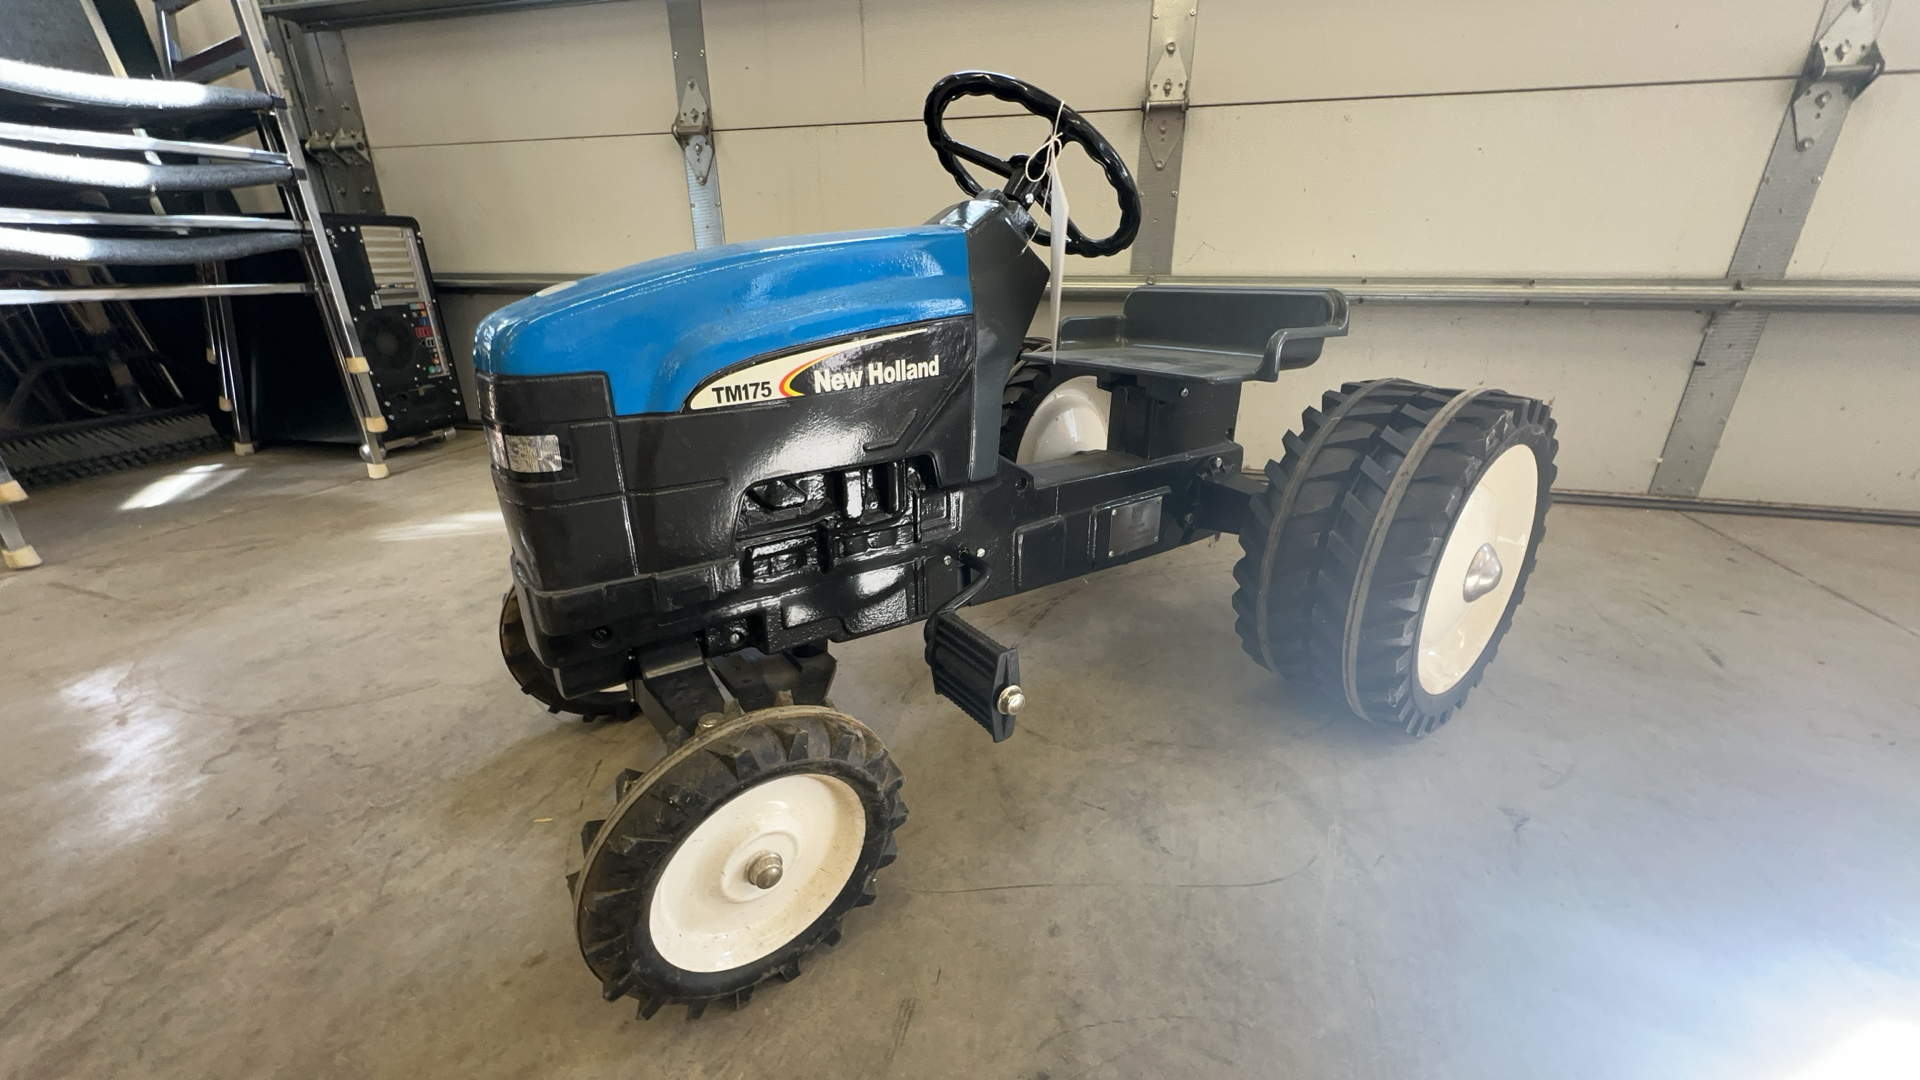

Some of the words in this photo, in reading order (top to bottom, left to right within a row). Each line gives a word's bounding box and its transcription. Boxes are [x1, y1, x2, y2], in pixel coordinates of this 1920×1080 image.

[814, 367, 862, 393] New
[868, 355, 939, 386] Holland
[712, 381, 772, 404] TM175
